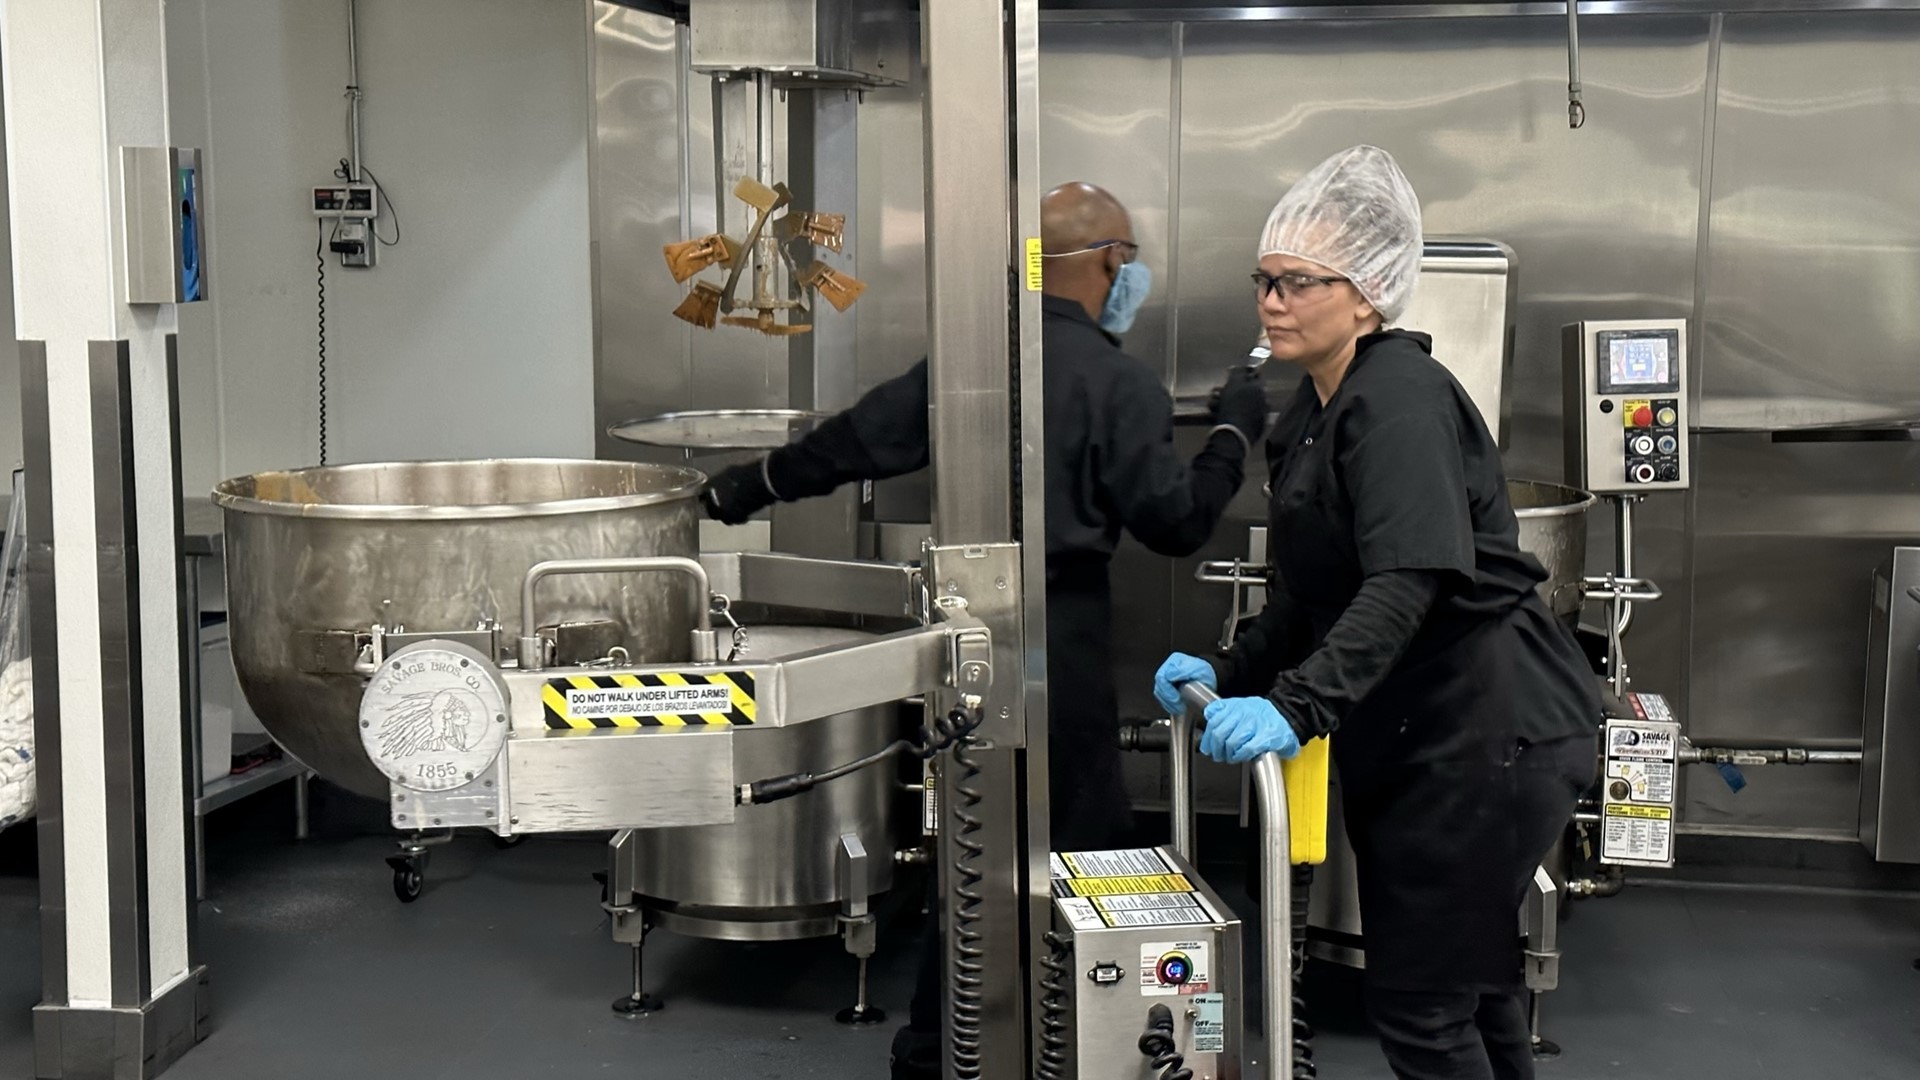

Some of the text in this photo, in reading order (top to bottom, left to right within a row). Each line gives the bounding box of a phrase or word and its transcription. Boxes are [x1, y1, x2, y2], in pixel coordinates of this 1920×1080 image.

[381, 662, 426, 694] SAVAGE
[572, 688, 729, 703] DO NOT WALK UNDER LIFTED ARMS!
[572, 706, 581, 714] NO
[582, 704, 605, 714] CAMINE
[605, 704, 619, 713] POR
[619, 703, 642, 713] DEBAJO
[642, 703, 651, 712] DE
[652, 702, 664, 711] LOS
[664, 701, 688, 711] BRAZOS
[1641, 732, 1671, 741] SAVAGE
[416, 761, 457, 779] 1855
